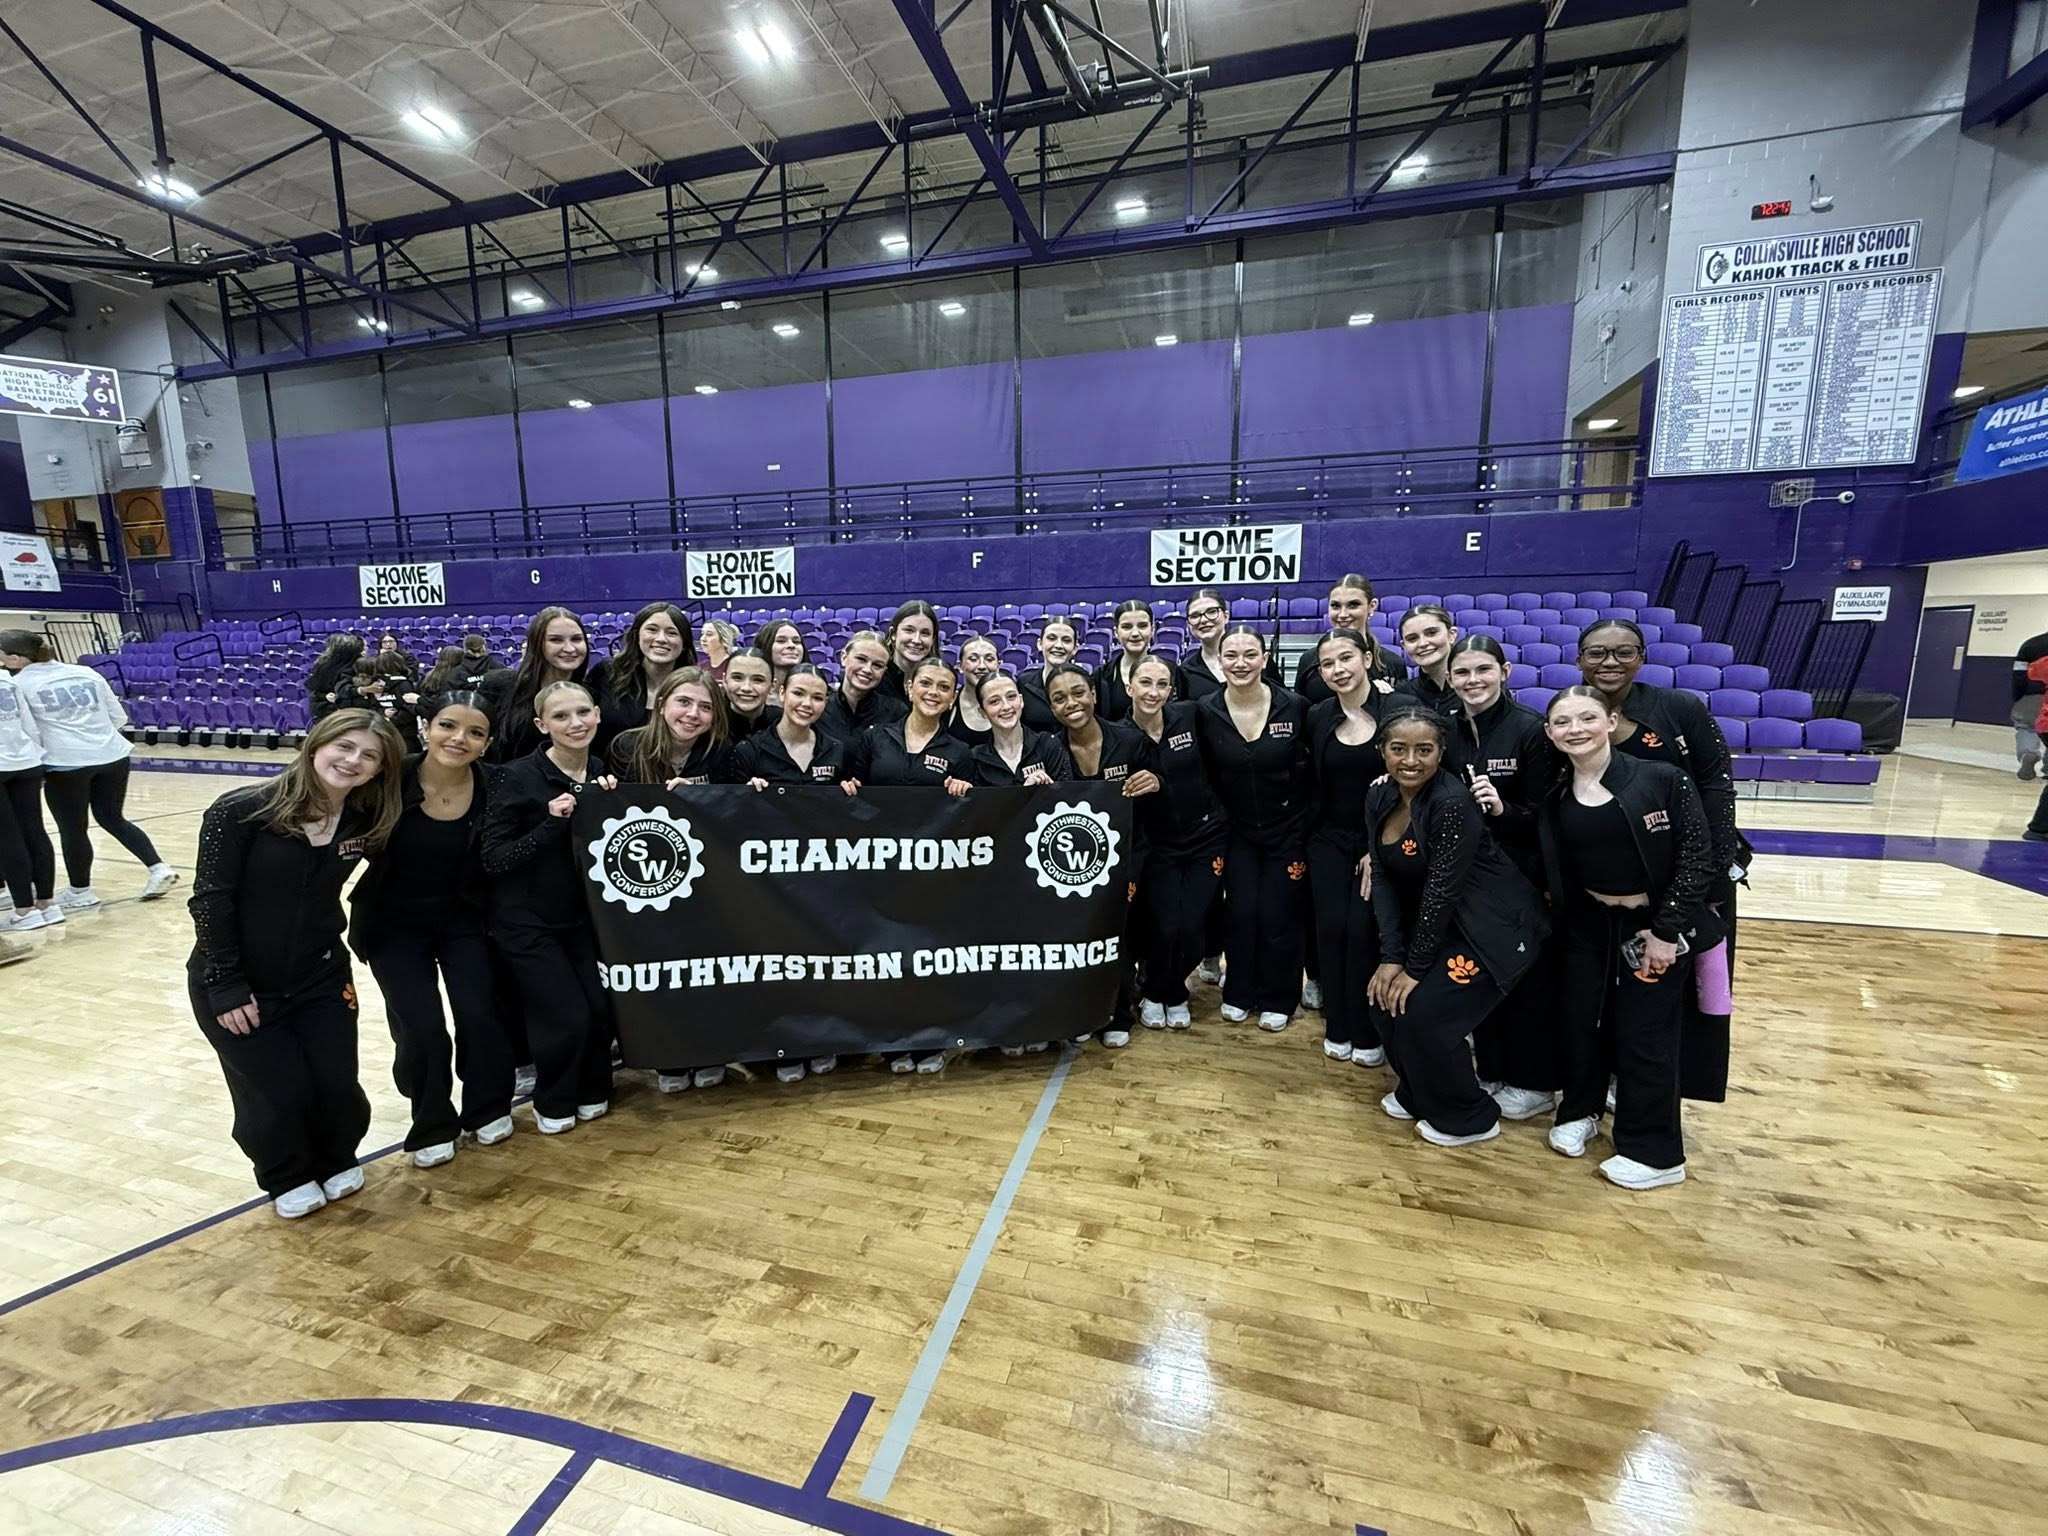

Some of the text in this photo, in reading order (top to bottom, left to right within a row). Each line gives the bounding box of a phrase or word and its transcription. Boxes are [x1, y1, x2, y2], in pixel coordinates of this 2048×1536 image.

[1734, 227, 1910, 266] COLLINSVILLE HIGH SCHOOL
[1731, 252, 1908, 283] KAHOK TRACK & FIELD
[1780, 286, 1820, 297] EVENTS
[1837, 274, 1933, 292] BOYS RECORDS
[1675, 292, 1765, 308] GIRLS RECORDS
[0, 370, 47, 380] ATIONAL
[5, 378, 76, 392] HIGH SCHOOL
[7, 385, 76, 398] BASKETBALL
[17, 393, 79, 406] CHAMPIONS
[93, 388, 116, 404] 61
[1178, 528, 1274, 556] HOME
[1466, 532, 1482, 551] E
[706, 550, 774, 574] HOME
[972, 552, 984, 568] F
[1155, 554, 1296, 583] SECTION
[375, 565, 428, 586] HOME
[531, 569, 541, 584] G
[692, 572, 792, 597] SECTION
[272, 580, 282, 593] H
[365, 585, 442, 605] SECTION
[1835, 600, 1886, 608] GYMNASIUM
[608, 822, 687, 854] SOUTHWESTERN
[1041, 816, 1106, 844] SOUTHWESTERN
[740, 835, 994, 874] CHAMPIONS
[1043, 859, 1104, 884] CONFERENCE
[611, 869, 685, 896] CONFERENCE
[597, 936, 1120, 992] SOUTHWESTERN CONFERENCE
